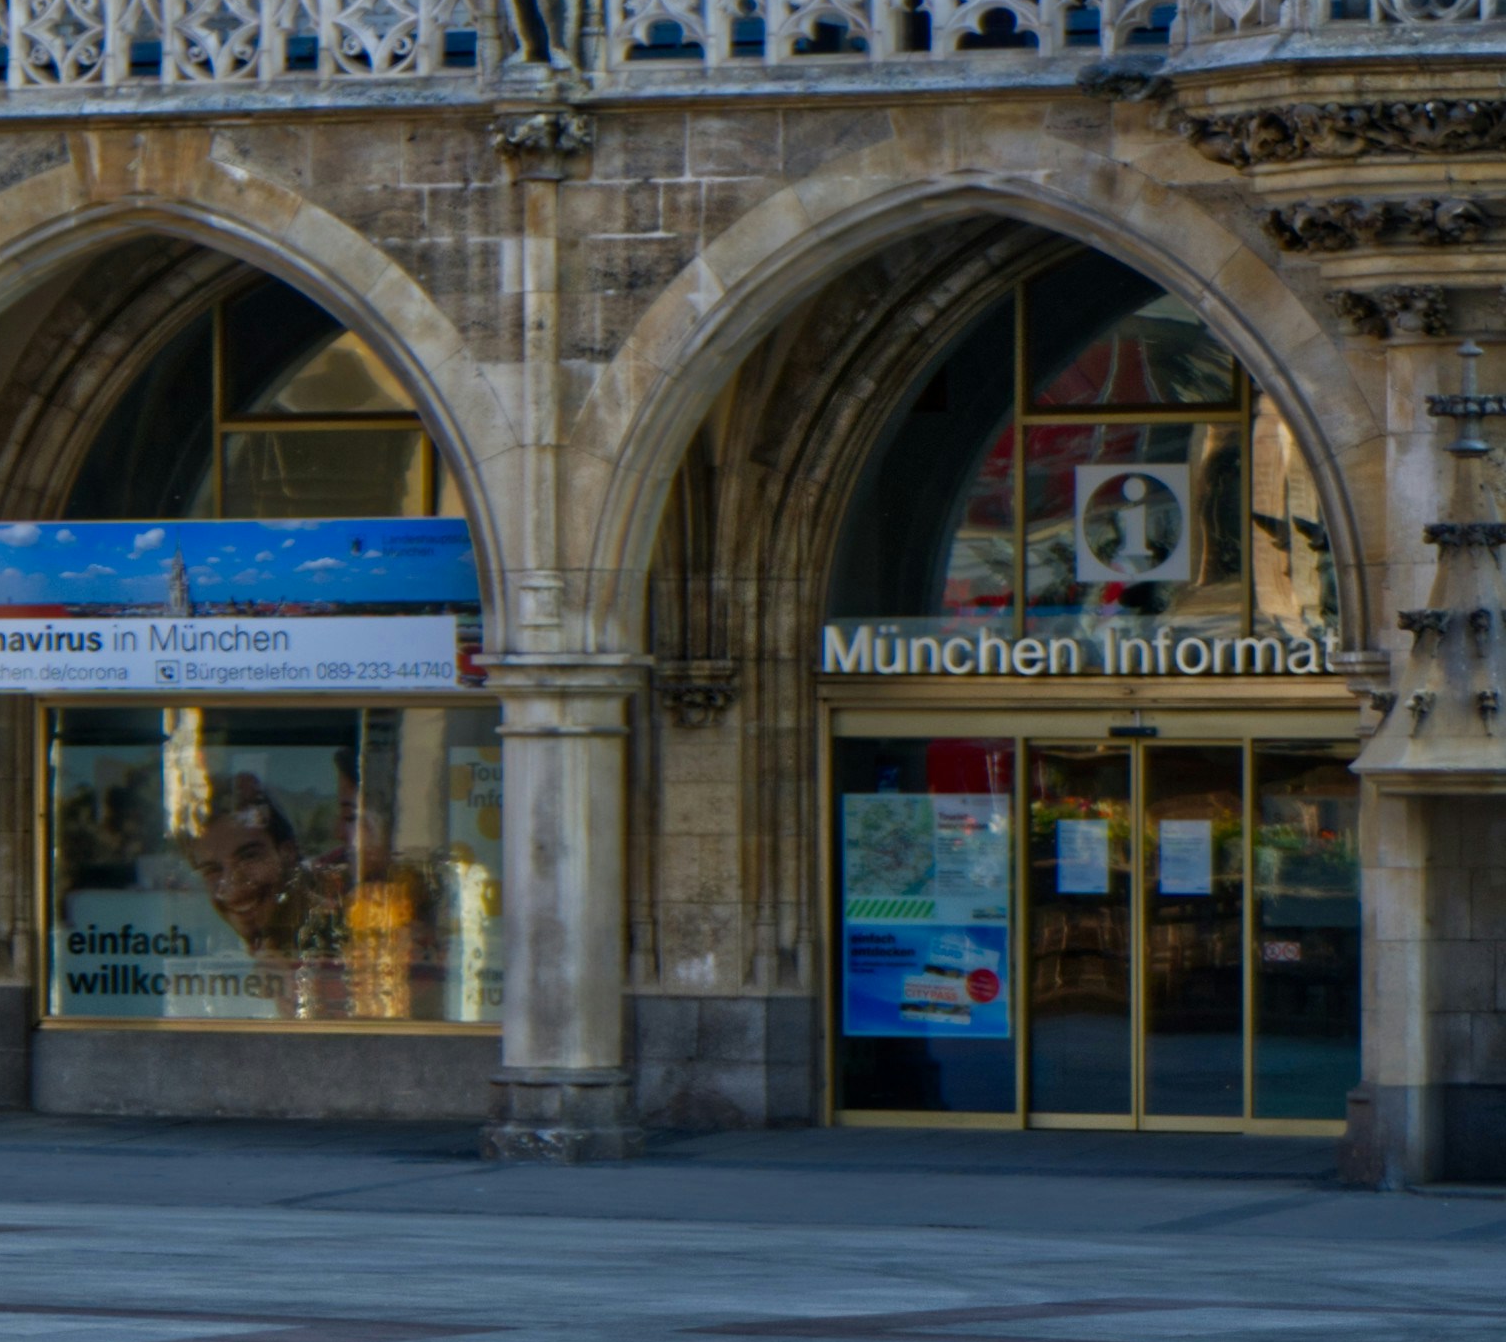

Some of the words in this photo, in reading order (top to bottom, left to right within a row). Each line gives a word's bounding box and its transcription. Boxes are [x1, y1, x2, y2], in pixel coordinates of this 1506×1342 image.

[113, 624, 136, 652] in
[149, 624, 290, 652] München
[823, 625, 1079, 675] München
[1104, 626, 1340, 675] Informat
[186, 661, 311, 682] Bürgertelefon
[316, 661, 452, 680] 089-233-44740
[66, 923, 192, 956] einfach
[66, 964, 285, 998] willkommen
